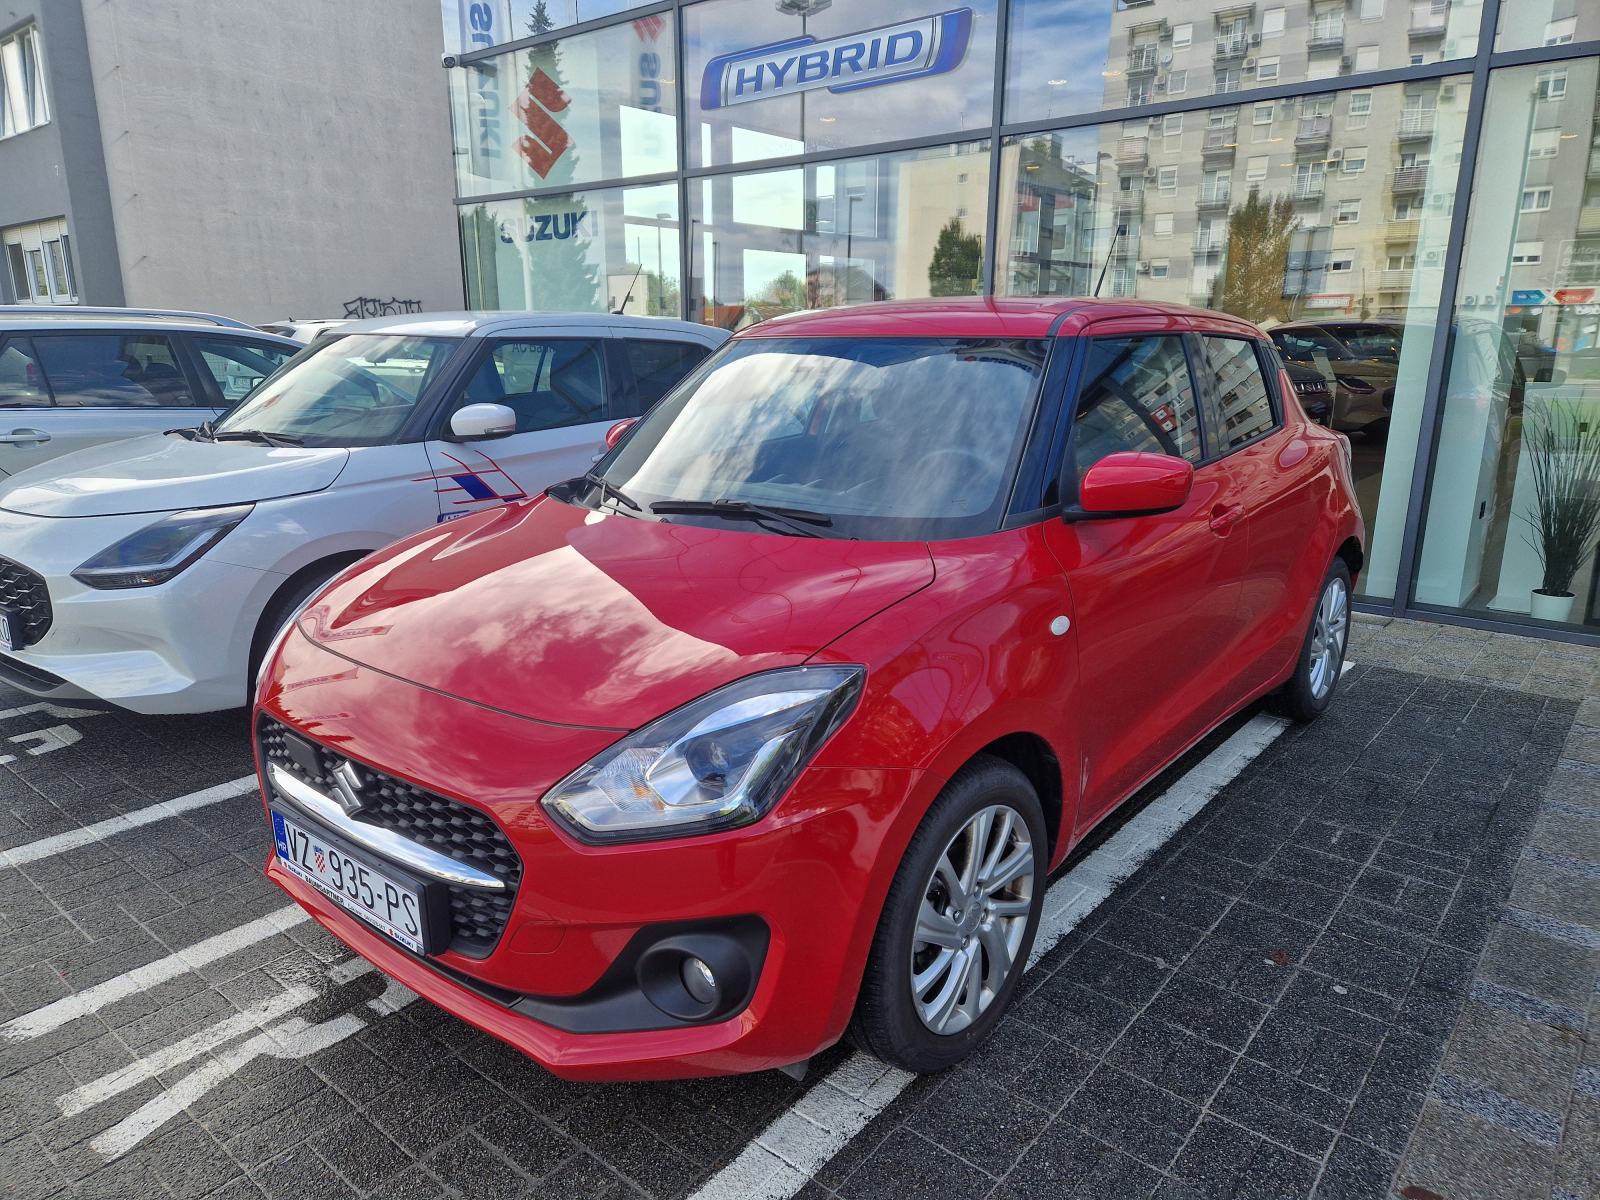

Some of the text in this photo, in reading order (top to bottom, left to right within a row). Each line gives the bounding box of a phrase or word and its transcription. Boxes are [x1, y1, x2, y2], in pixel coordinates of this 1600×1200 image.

[735, 30, 923, 97] HYBRID
[277, 840, 288, 853] HR
[286, 823, 419, 937] VZ 935-PS
